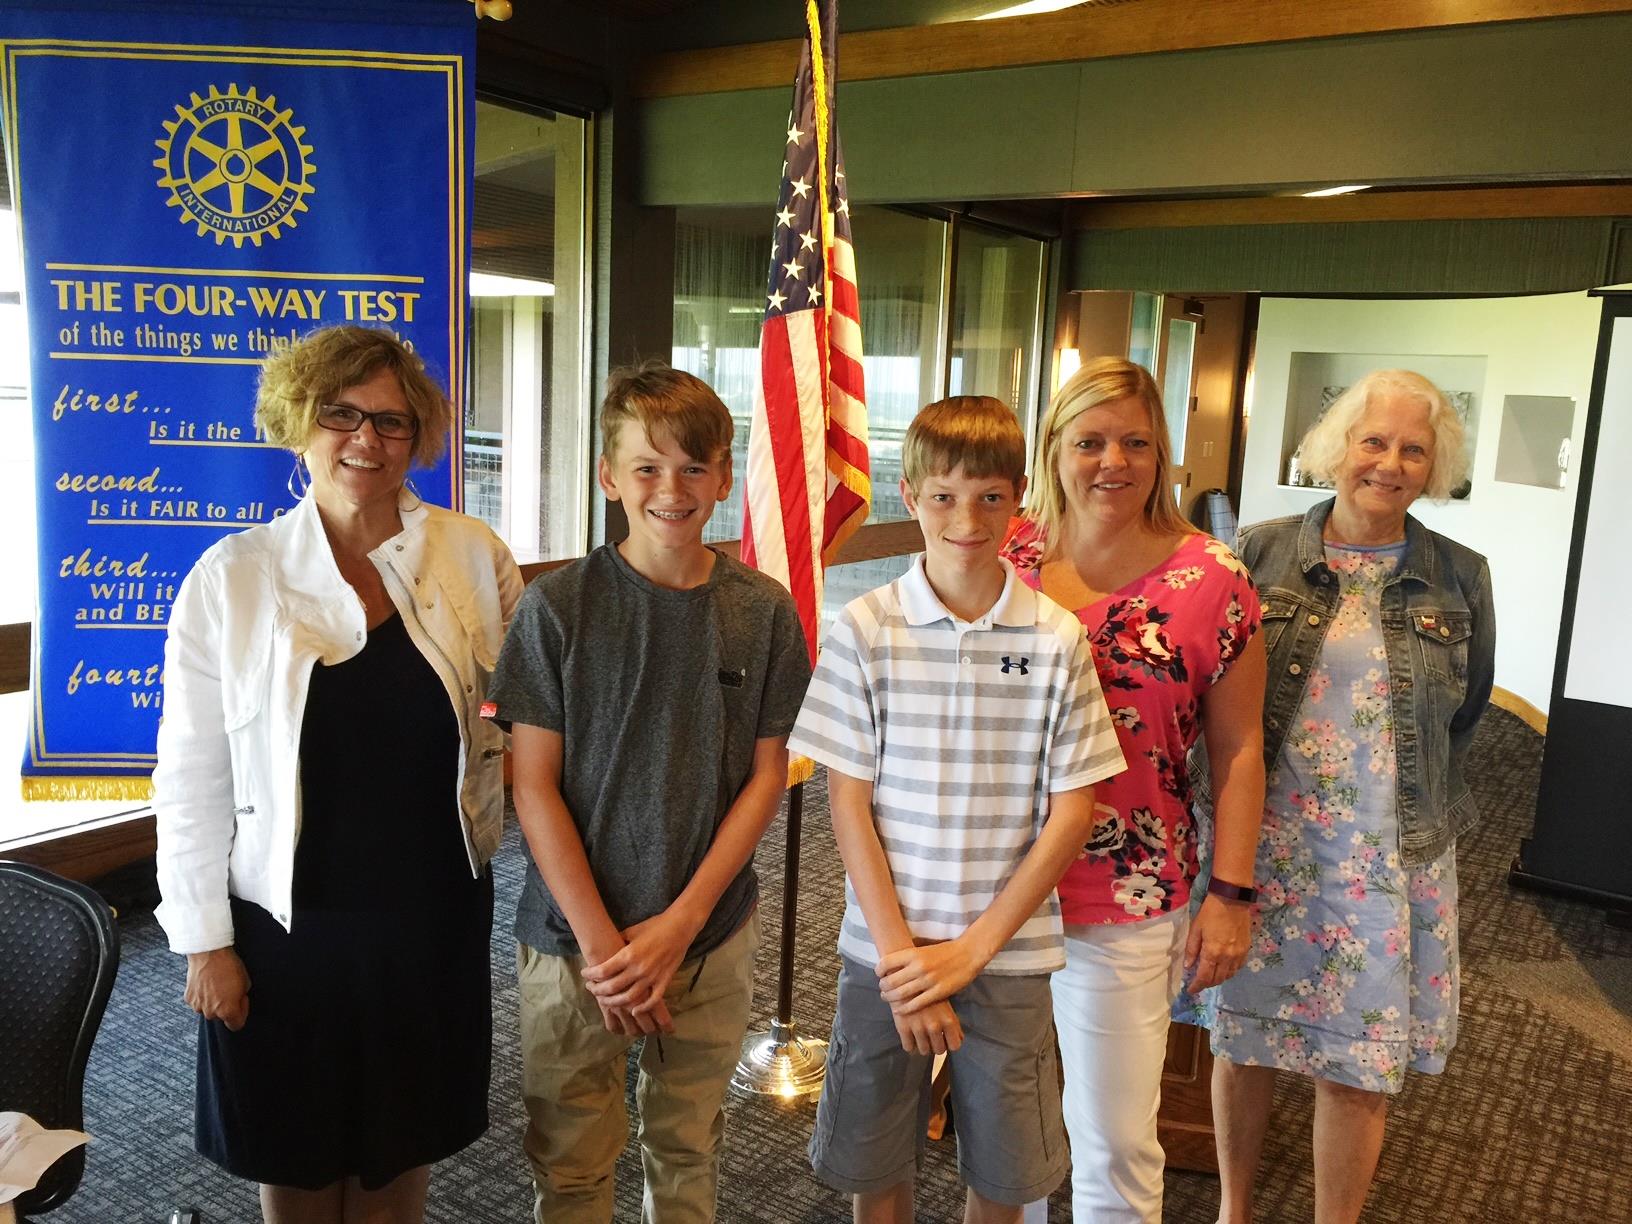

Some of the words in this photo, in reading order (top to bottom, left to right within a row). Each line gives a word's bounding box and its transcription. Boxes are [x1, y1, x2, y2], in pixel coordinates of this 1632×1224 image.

[203, 100, 266, 118] ROTARY
[180, 188, 295, 232] INTERNATIONAL
[51, 280, 122, 312] THE
[134, 283, 326, 320] FOUR-WAY
[338, 290, 421, 323] TEST
[59, 321, 80, 346] of
[91, 322, 124, 347] the
[135, 324, 202, 356] things
[212, 333, 238, 351] we
[150, 420, 168, 438] Is
[179, 420, 196, 438] it
[207, 421, 242, 440] the
[91, 499, 110, 516] Is
[121, 499, 138, 517] it
[151, 500, 198, 518] FAIR
[206, 502, 227, 519] to
[236, 502, 263, 520] all
[90, 583, 144, 600] Will
[155, 583, 174, 600] it
[75, 603, 124, 620] and
